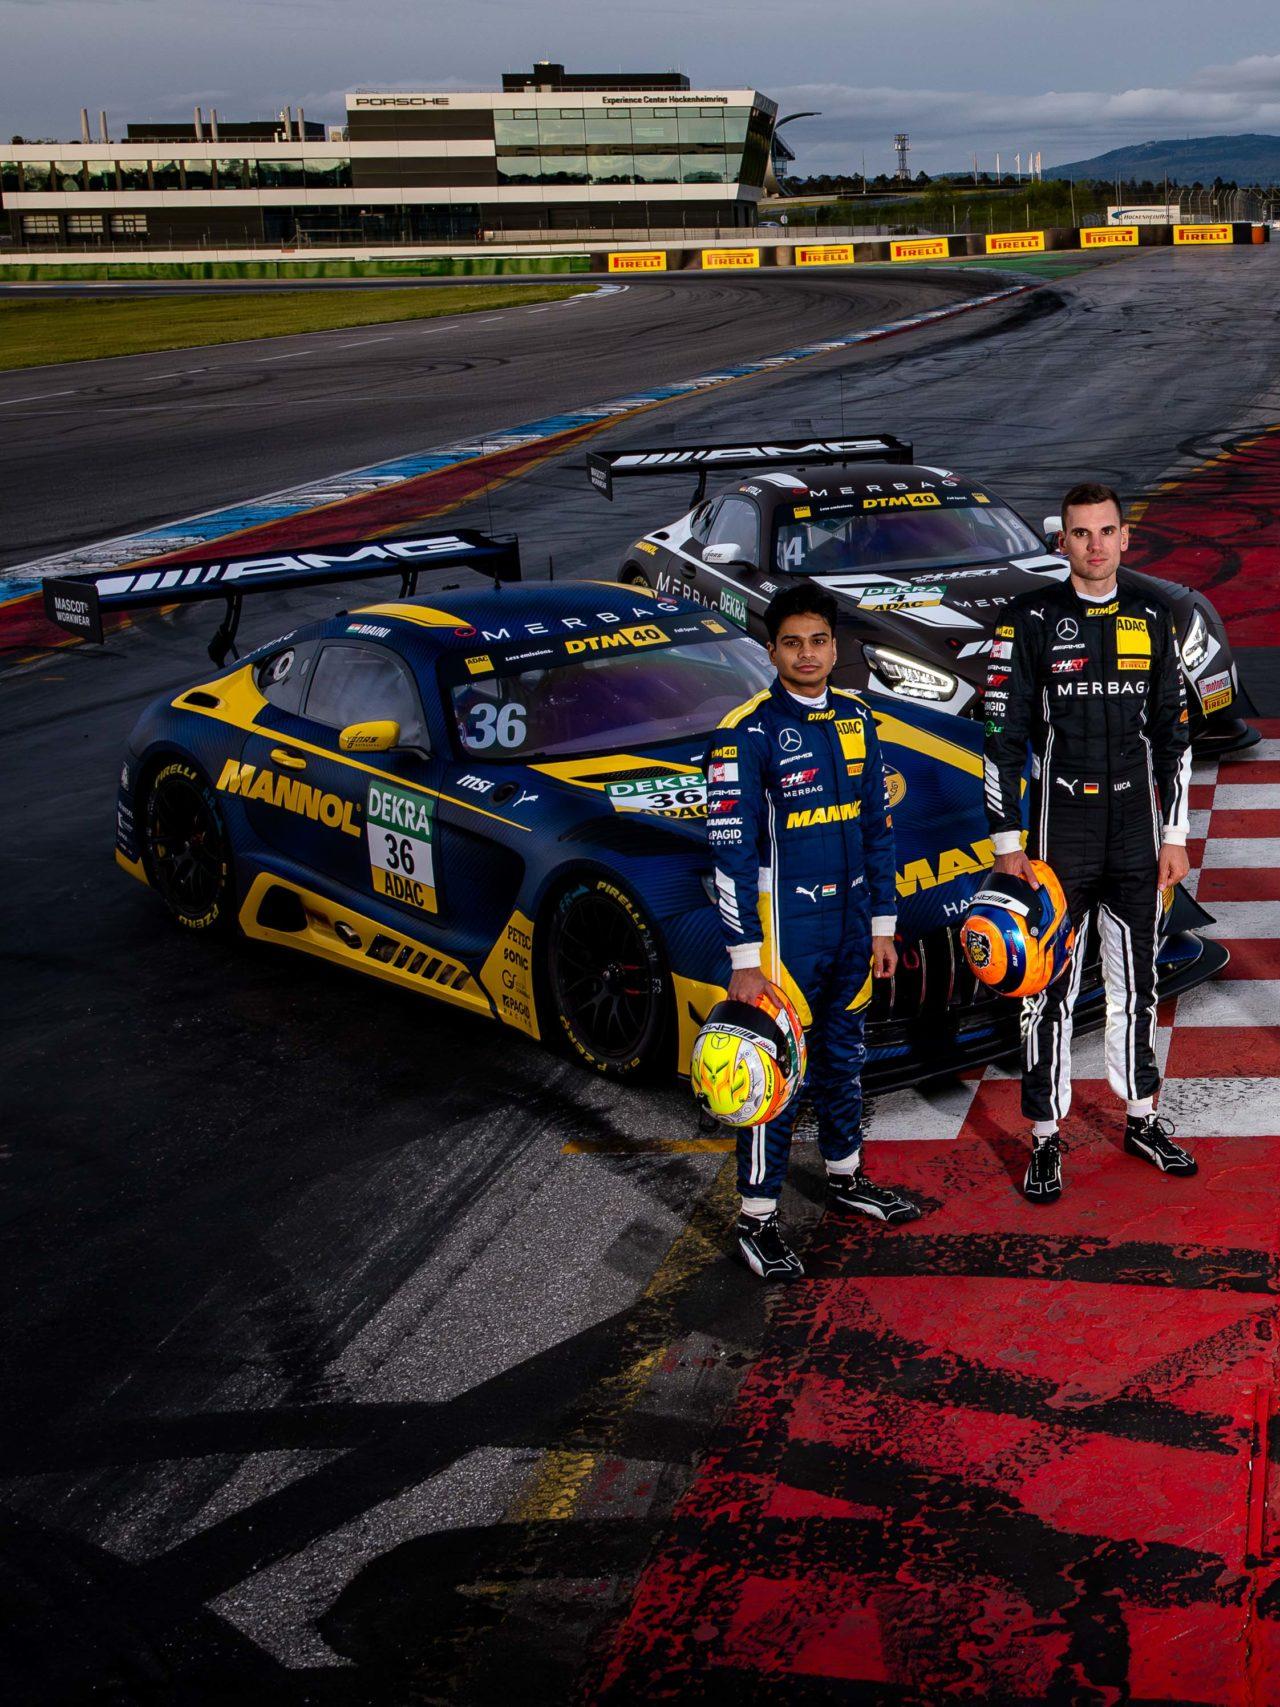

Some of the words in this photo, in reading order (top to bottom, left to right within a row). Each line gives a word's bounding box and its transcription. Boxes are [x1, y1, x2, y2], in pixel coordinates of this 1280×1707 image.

[356, 97, 449, 106] PORSCHE
[602, 96, 642, 106] Experience
[643, 95, 668, 105] Center
[669, 94, 728, 105] Hockenheimring
[991, 236, 1039, 250] PIRELLI
[1085, 230, 1134, 245] PIRELLI
[1179, 228, 1229, 241] PIRELLI
[801, 249, 850, 263] PIRELLI
[895, 242, 945, 258] PIRELLI
[613, 254, 662, 269] PIRELLI
[706, 252, 755, 266] PIRELLI
[703, 438, 890, 462] AMG
[809, 479, 960, 498] MERBAG
[862, 496, 909, 510] DTM
[913, 493, 934, 505] 40
[218, 535, 476, 582] AMG
[784, 536, 806, 567] 4
[866, 584, 944, 596] DEKRA
[889, 594, 907, 602] 4
[719, 590, 748, 624] DEKRA
[872, 599, 925, 612] ADAC
[953, 595, 1018, 609] MER
[55, 611, 91, 628] WORKWEAR
[480, 602, 681, 643] MERBAG
[1117, 618, 1147, 634] ADAC
[358, 624, 392, 638] MAINI
[563, 632, 627, 656] DTM
[631, 627, 661, 643] 40
[466, 654, 490, 665] ADAC
[1120, 658, 1149, 670] PIRELLI
[1056, 680, 1146, 697] MERBAG
[1204, 692, 1231, 711] PIRELLI
[464, 702, 527, 750] 36
[838, 720, 863, 736] ADAC
[154, 762, 200, 790] PIRELLI
[456, 773, 496, 794] msi
[783, 784, 825, 799] MERBAG
[1113, 780, 1132, 792] LUCA
[215, 759, 362, 838] MANNOL
[647, 789, 703, 809] 36
[366, 786, 433, 837] DEKRA
[385, 833, 416, 875] 36
[384, 874, 425, 908] ADAC
[596, 880, 648, 931] PIRELLI
[507, 924, 531, 951] PETEC
